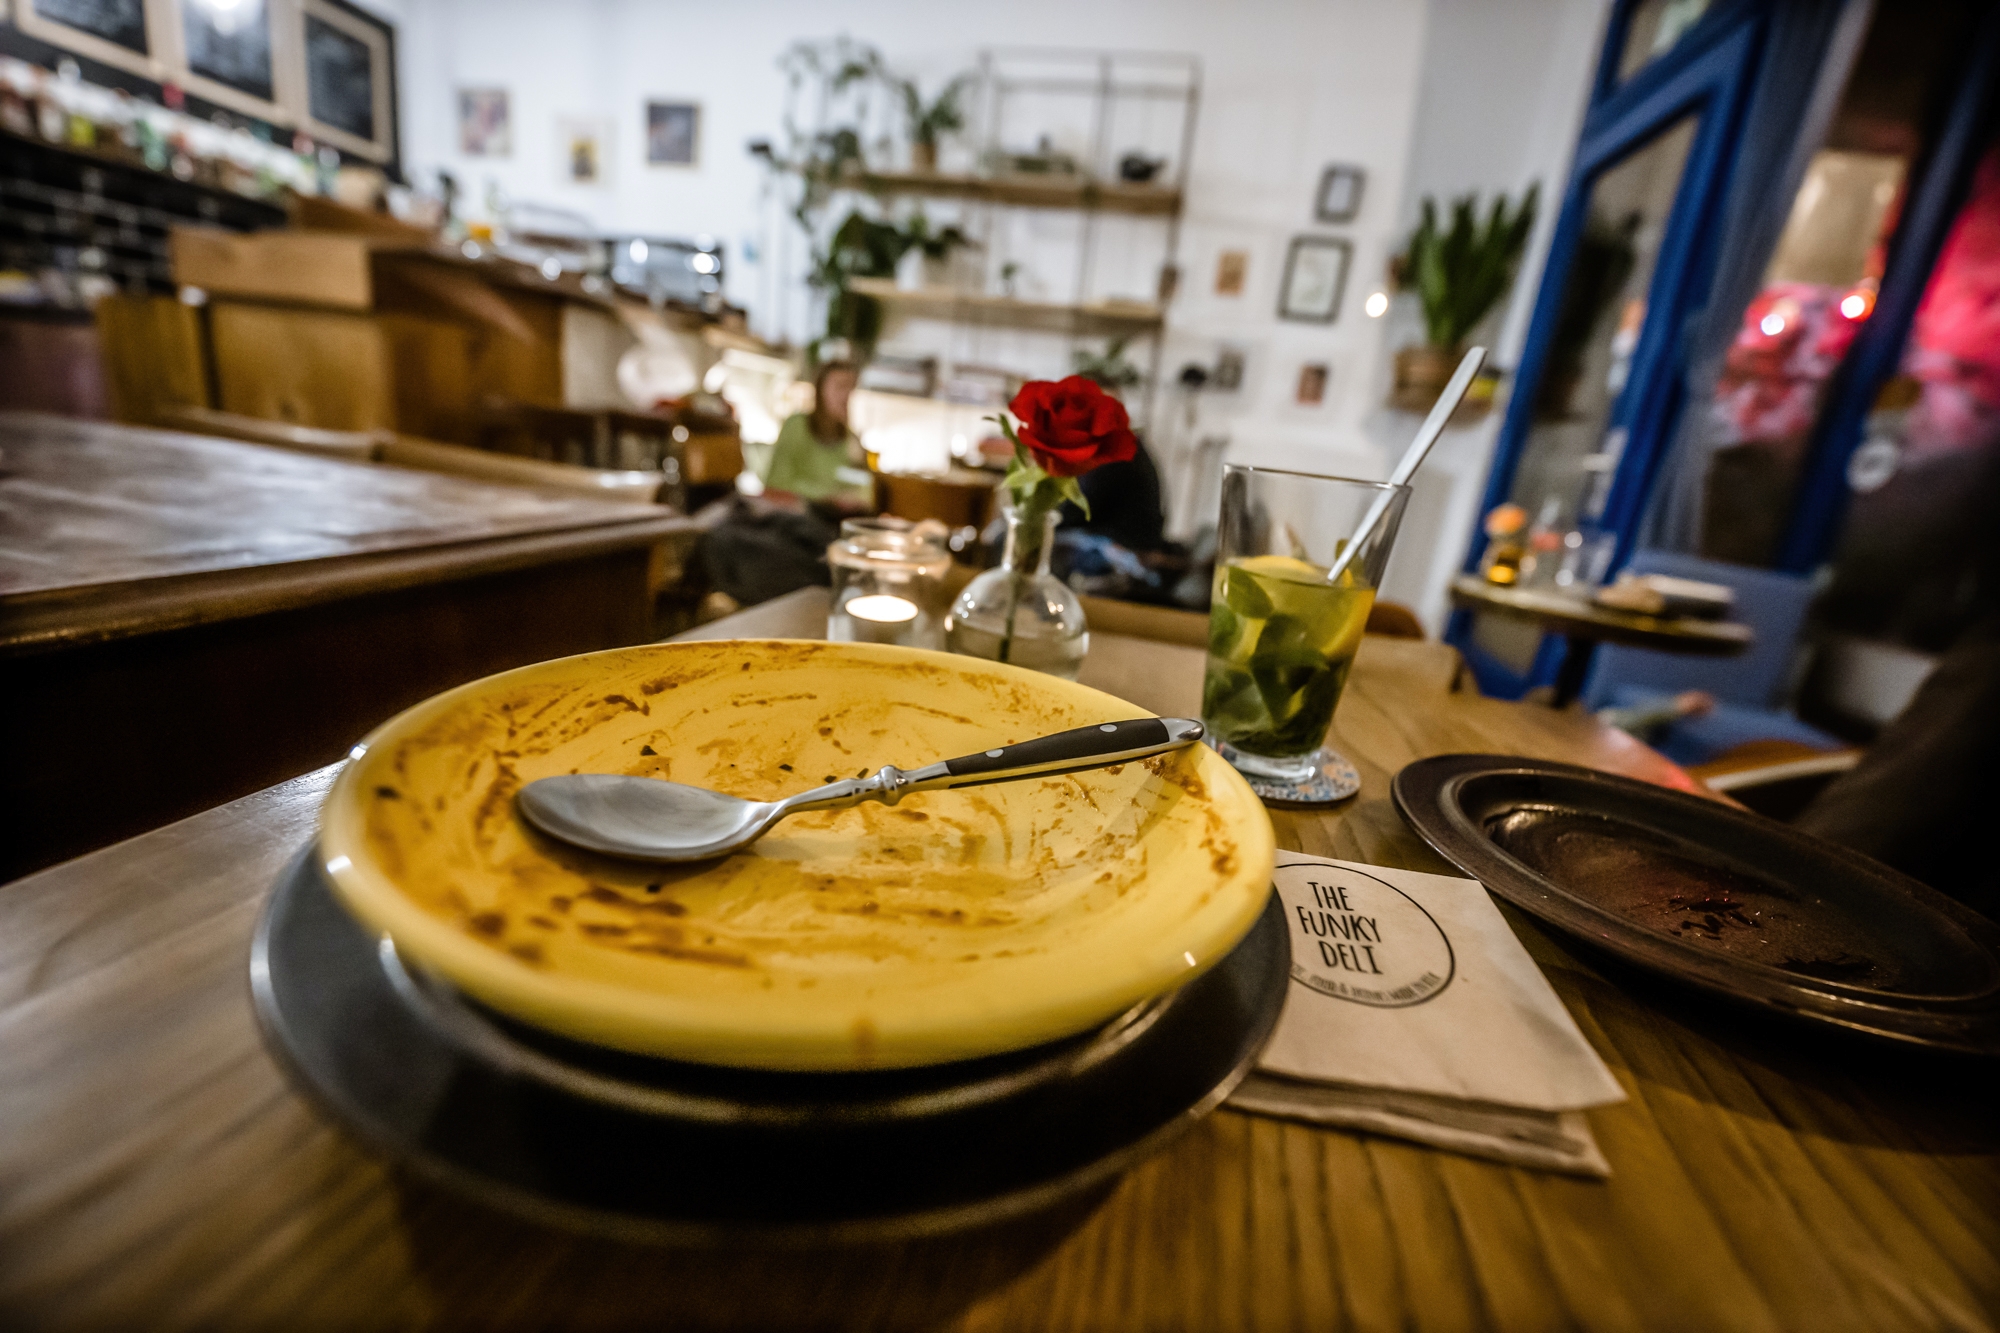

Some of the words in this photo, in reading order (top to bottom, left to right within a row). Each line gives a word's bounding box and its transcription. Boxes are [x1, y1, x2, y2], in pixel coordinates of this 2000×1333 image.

[1307, 881, 1354, 911] THE
[1296, 906, 1381, 943] FUNKY
[1317, 940, 1384, 975] DELI
